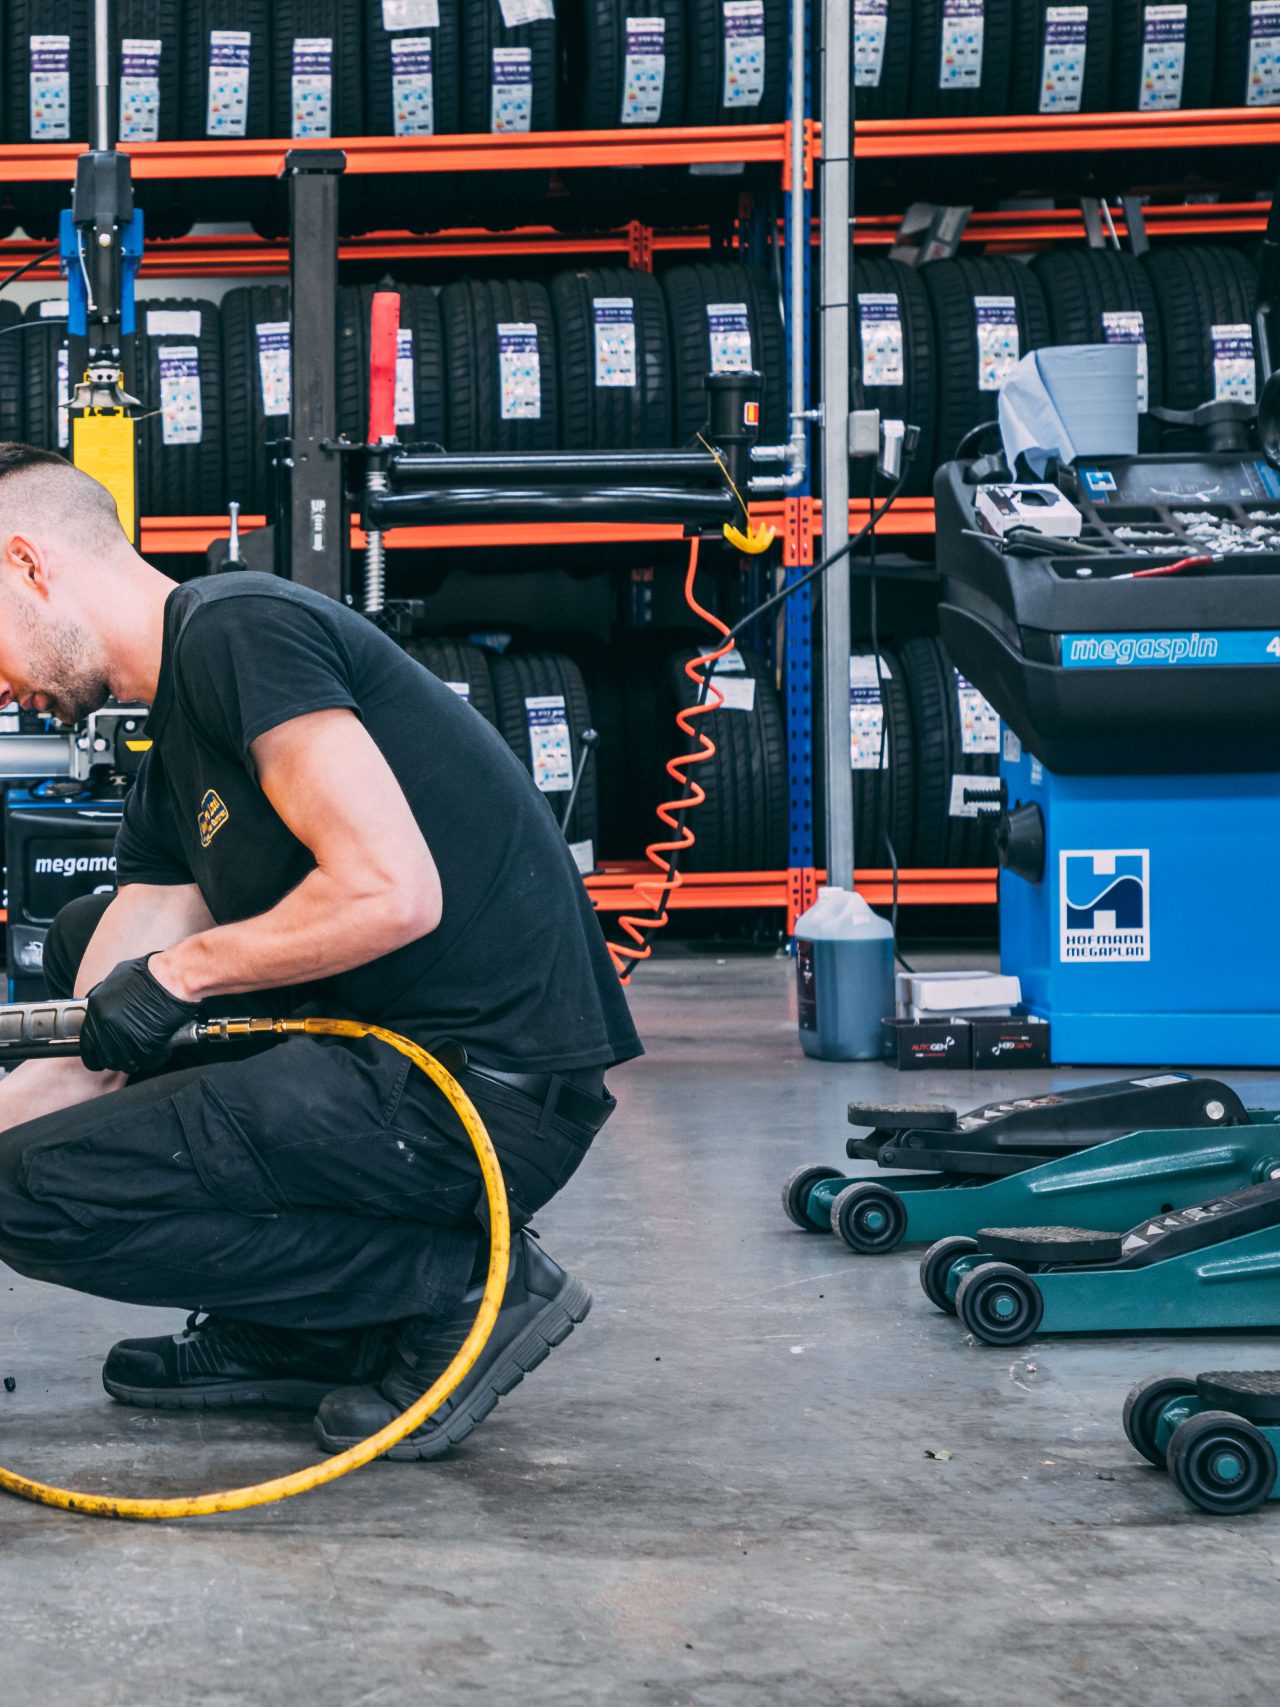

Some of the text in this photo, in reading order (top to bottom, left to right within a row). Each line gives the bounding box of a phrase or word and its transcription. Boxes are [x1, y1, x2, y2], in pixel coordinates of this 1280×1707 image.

[311, 499, 326, 512] UP
[1070, 632, 1218, 665] megaspin
[1066, 935, 1144, 945] HOFMANN
[1066, 947, 1144, 957] MEGAPLAN
